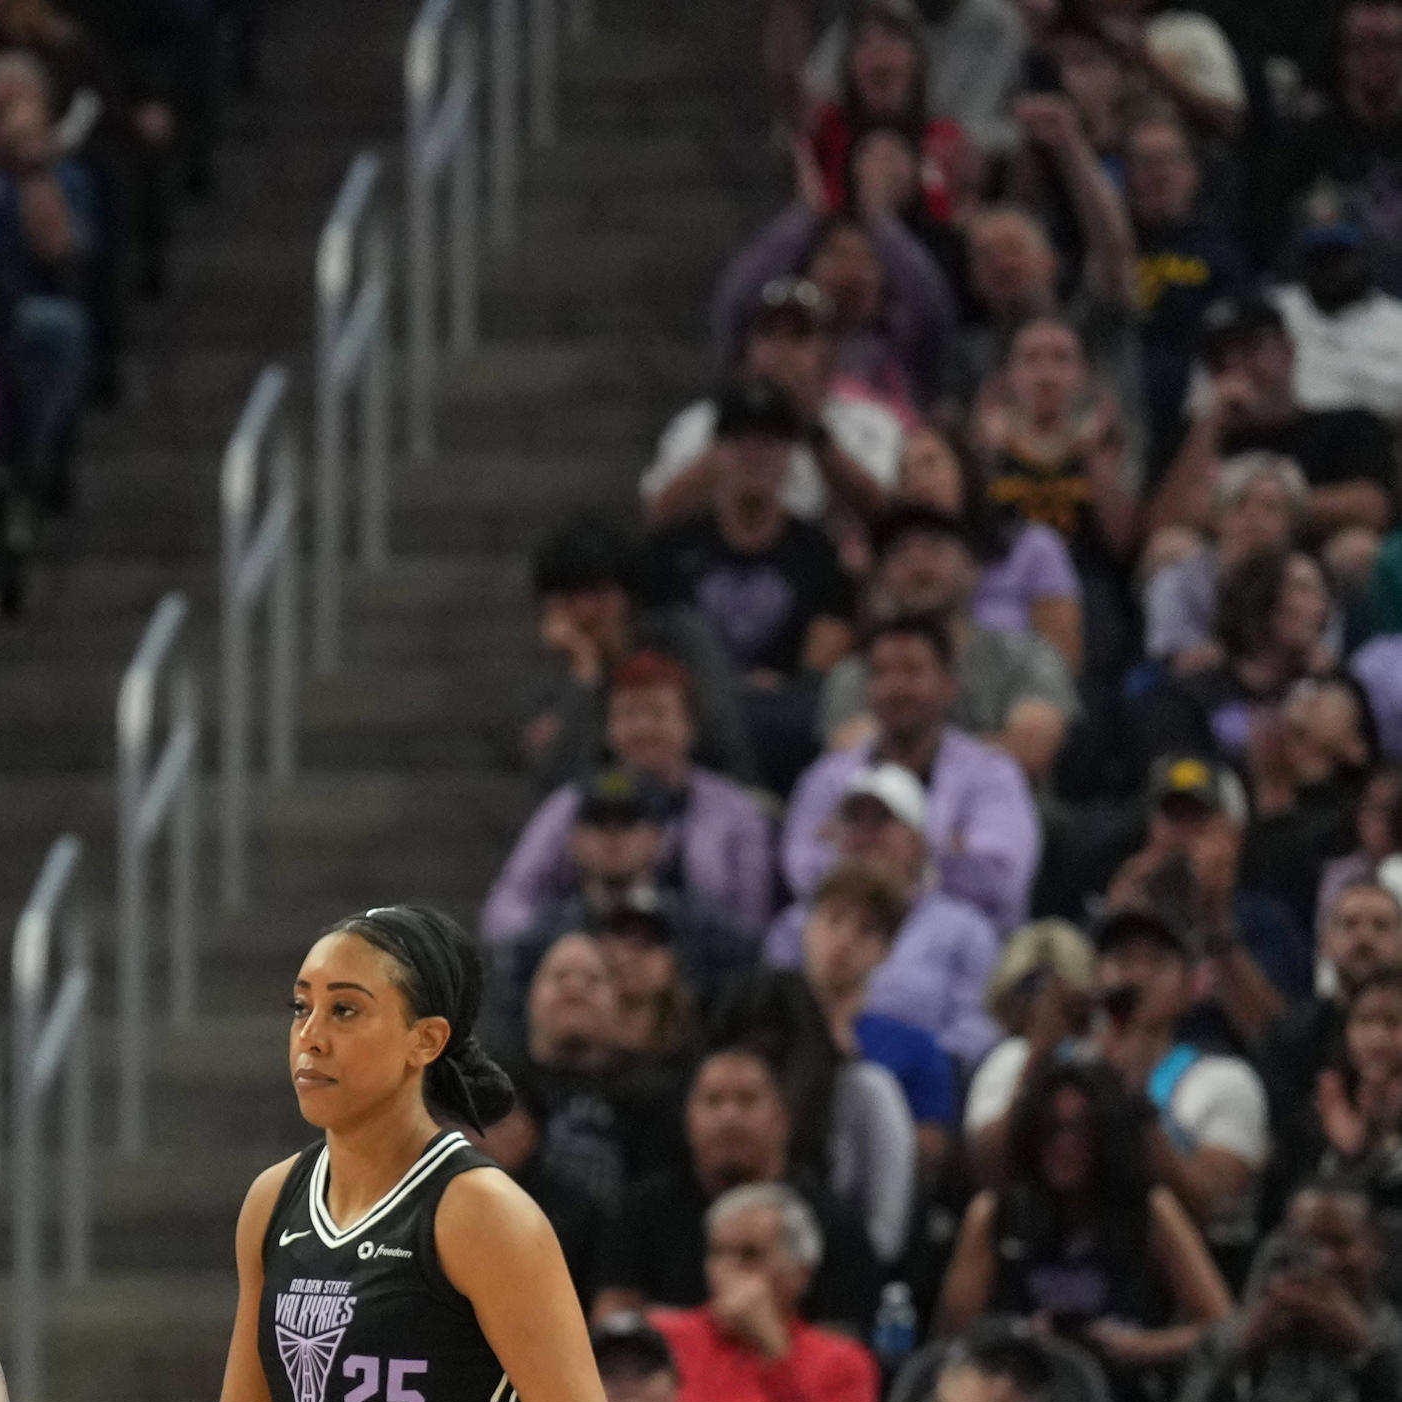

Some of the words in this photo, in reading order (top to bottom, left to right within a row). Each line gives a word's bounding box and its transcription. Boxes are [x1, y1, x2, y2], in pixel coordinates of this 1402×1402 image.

[373, 1243, 413, 1259] freedom
[289, 1278, 323, 1294] GOLDEN
[322, 1280, 352, 1295] STATE
[275, 1292, 357, 1338] VALKYRIES
